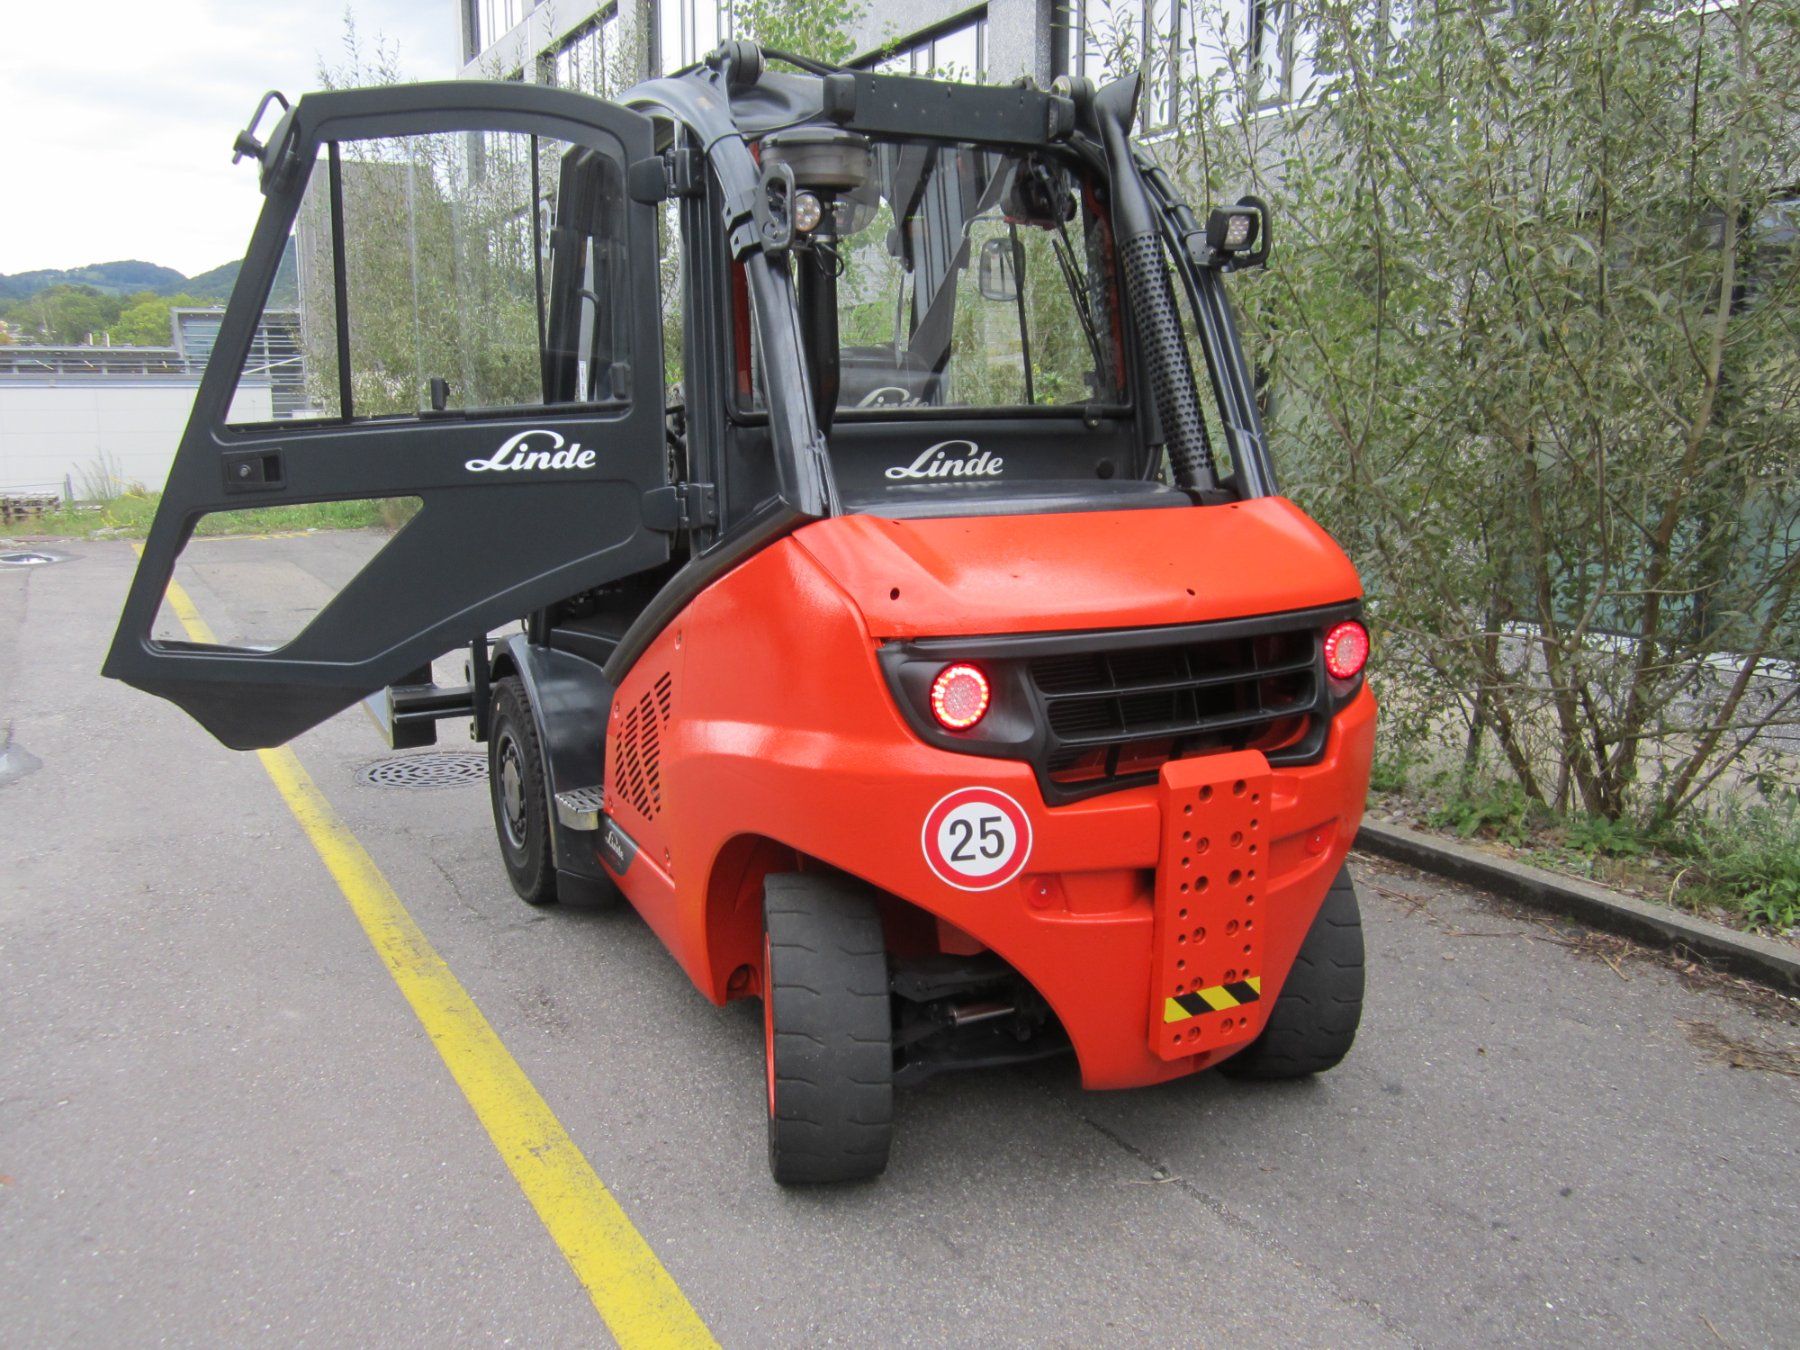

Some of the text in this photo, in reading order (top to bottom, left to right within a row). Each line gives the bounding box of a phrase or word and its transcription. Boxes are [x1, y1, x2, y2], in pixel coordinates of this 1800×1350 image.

[464, 429, 597, 472] Linde
[884, 439, 1004, 479] Linde
[949, 815, 1005, 862] 25
